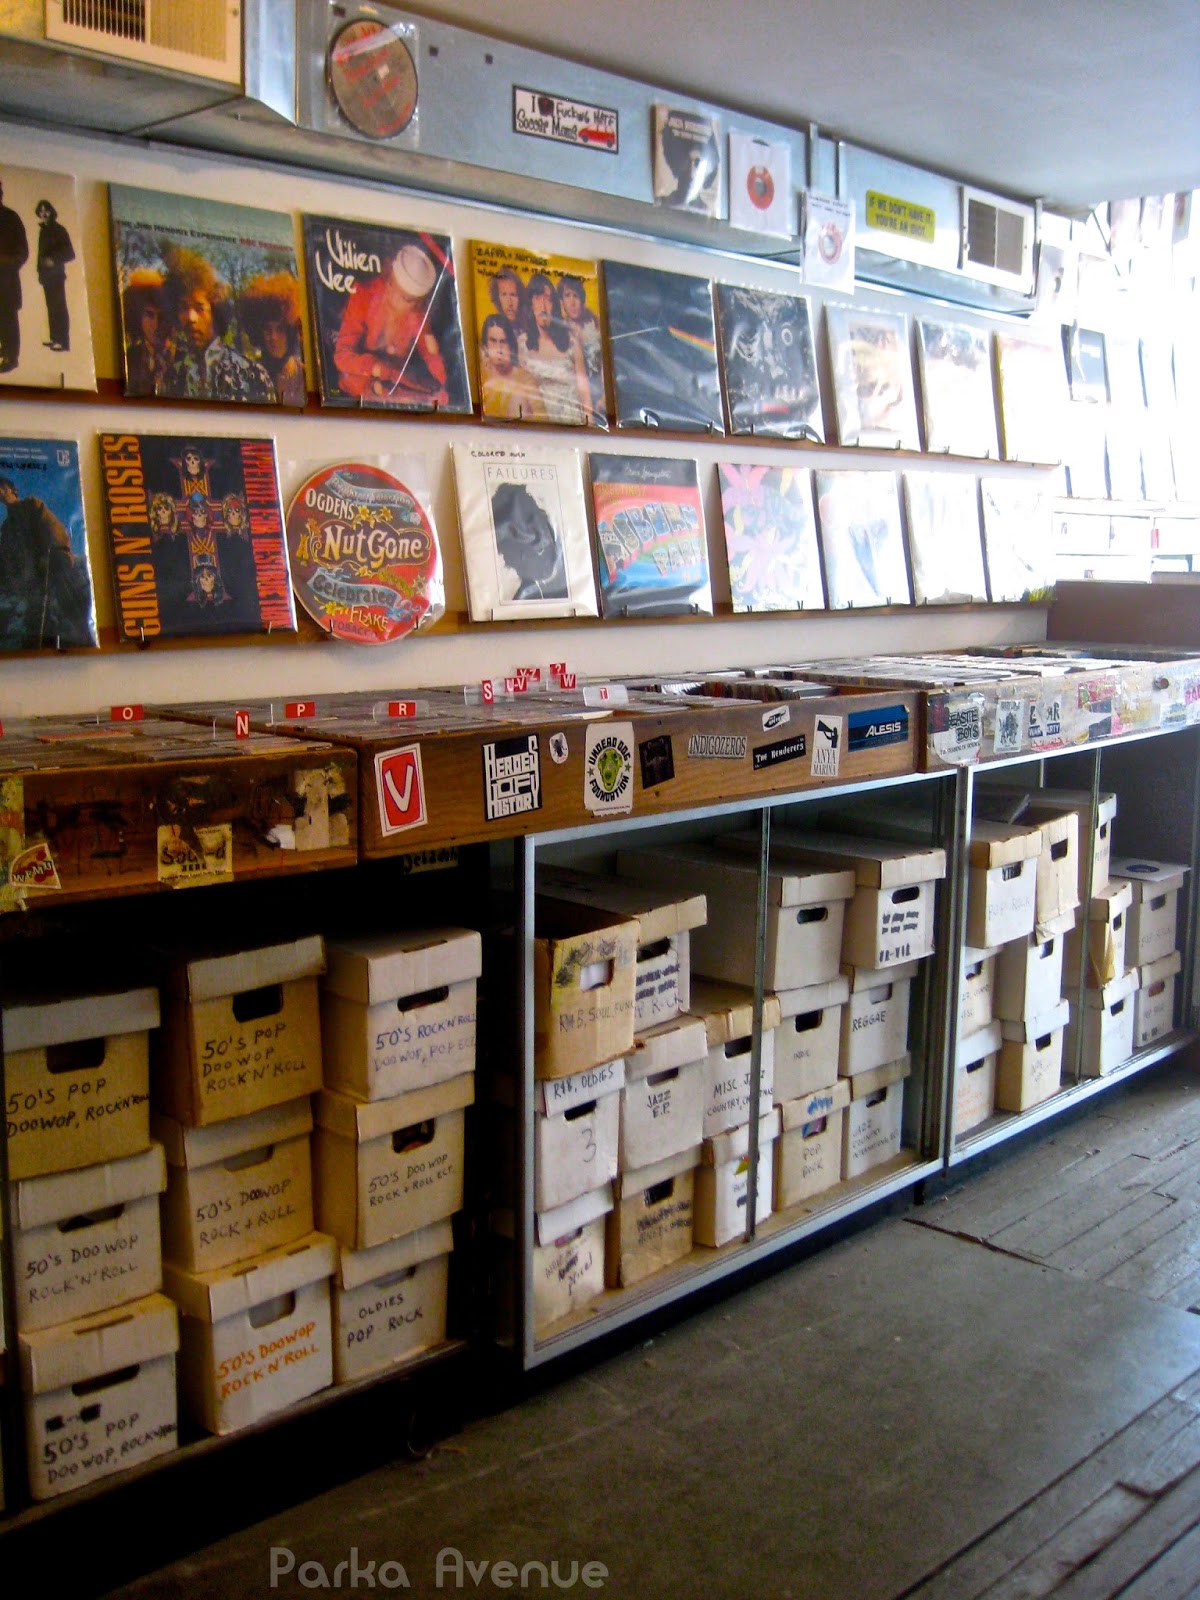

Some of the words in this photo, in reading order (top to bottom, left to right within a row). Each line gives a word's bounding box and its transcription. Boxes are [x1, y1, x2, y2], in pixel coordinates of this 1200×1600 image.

[877, 198, 887, 212] WE
[899, 220, 909, 232] AN
[315, 250, 357, 294] Vee
[102, 434, 149, 525] ROSES
[486, 465, 555, 481] FAILURES
[116, 562, 162, 637] GUNS
[349, 605, 392, 633] FLAKE
[483, 682, 493, 700] S
[563, 675, 574, 688] W
[600, 688, 607, 699] T
[122, 707, 134, 721] O
[297, 703, 306, 717] P
[398, 703, 408, 716] R
[236, 714, 249, 736] N
[948, 707, 979, 728] EASTIE
[864, 721, 902, 738] ALESIS
[956, 723, 980, 744] BOYS
[483, 735, 539, 780] HEROES
[588, 736, 618, 766] UNDEAD
[616, 737, 632, 762] DOG
[689, 735, 747, 757] INDIGOZEROS
[814, 749, 837, 765] ANYA
[813, 764, 837, 777] MARINA
[384, 764, 415, 813] V
[486, 773, 541, 820] HISTORY
[588, 774, 630, 803] FOUNDATION
[852, 1009, 887, 1033] REGGAE
[202, 1036, 247, 1060] 50'S
[254, 1022, 287, 1044] POP
[375, 1027, 412, 1051] 50'S
[581, 1063, 614, 1089] OLDIES
[6, 1088, 56, 1115] 50'S
[67, 1076, 107, 1101] POP
[647, 1088, 672, 1109] JAZZ
[581, 1128, 597, 1163] 3
[367, 1171, 400, 1194] 50'S
[369, 1189, 402, 1208] ROCK
[412, 1175, 435, 1191] ROLL
[196, 1199, 232, 1223] 50'S
[198, 1220, 241, 1248] ROCK
[256, 1204, 296, 1226] ROLL
[358, 1293, 405, 1320] OLDIES
[346, 1324, 375, 1350] POP
[387, 1305, 424, 1332] ROCK
[216, 1348, 256, 1380] 50'S
[43, 1431, 90, 1465] 50'S
[105, 1412, 140, 1437] POP
